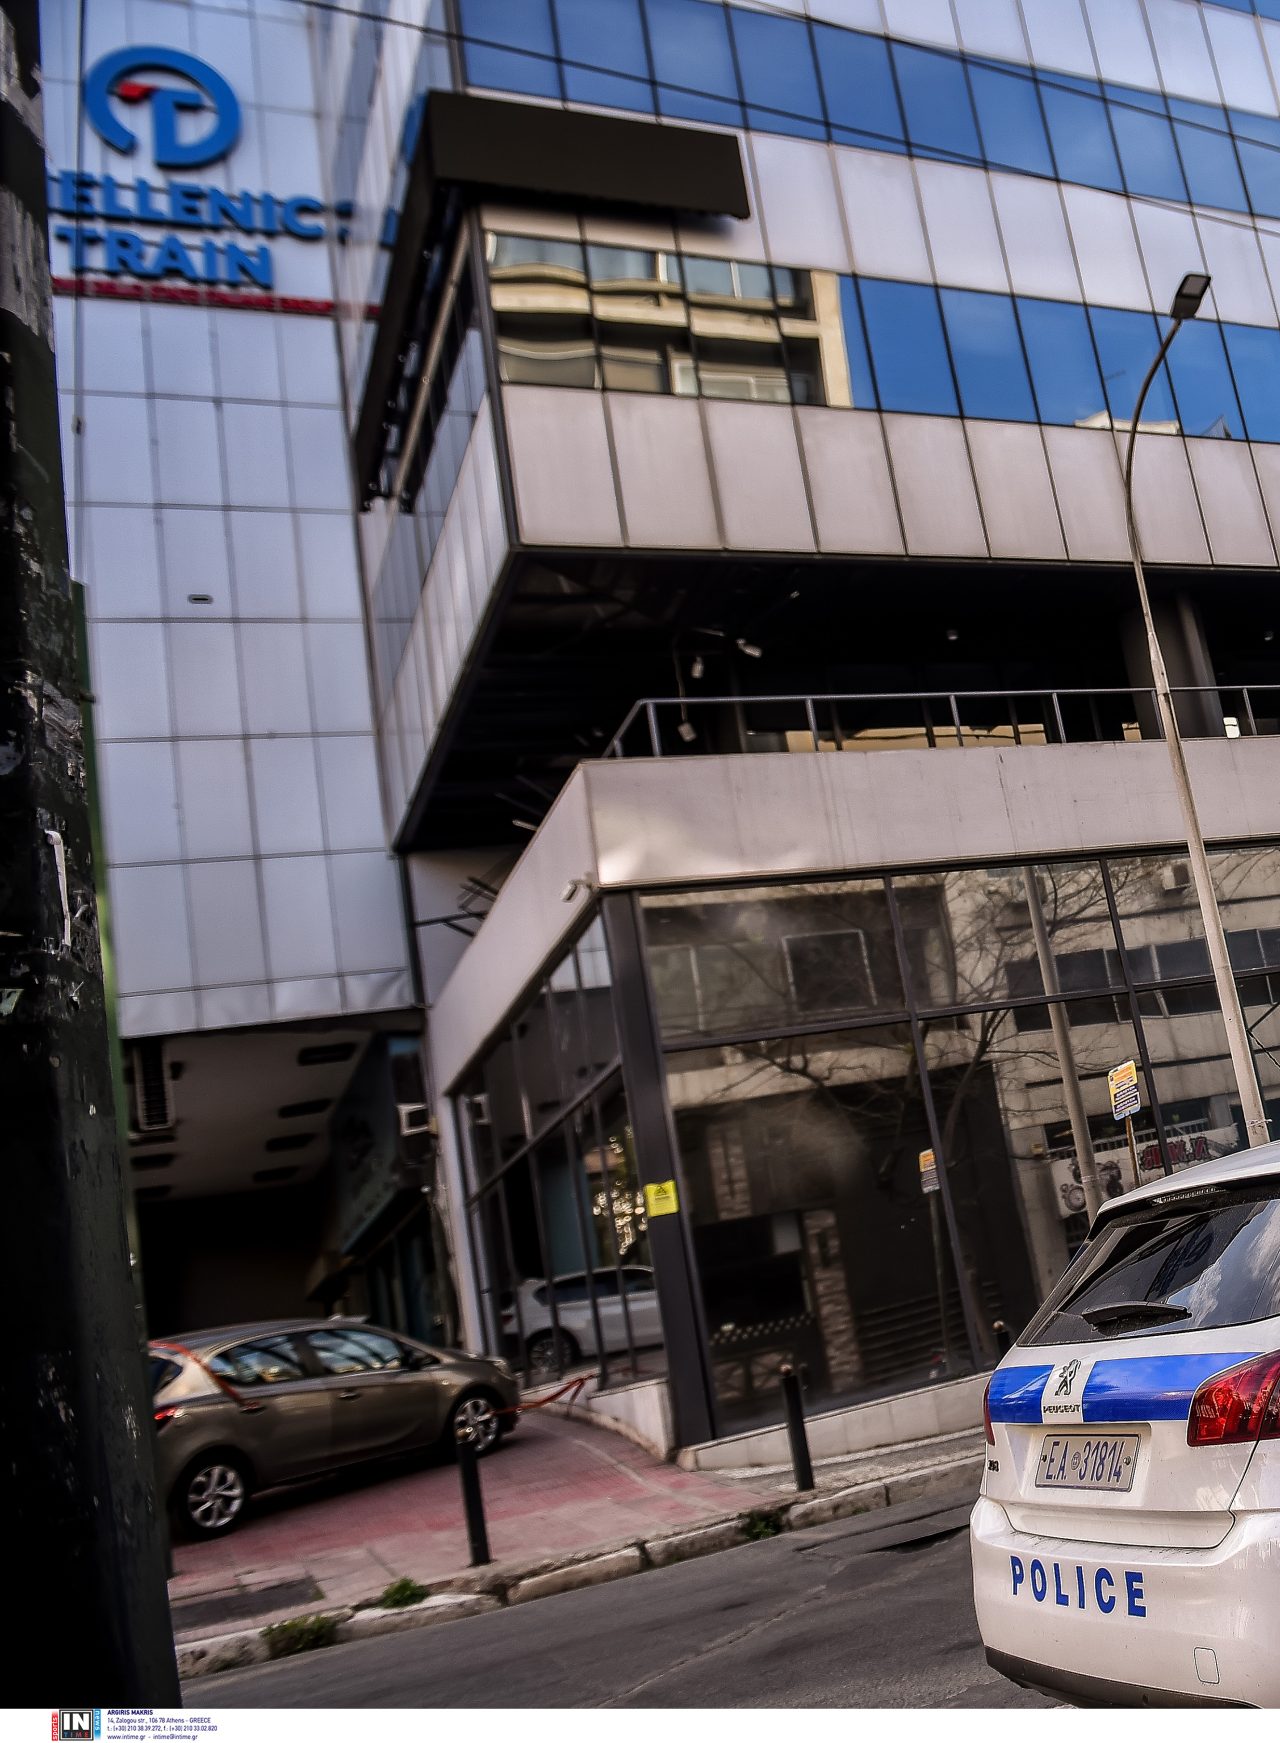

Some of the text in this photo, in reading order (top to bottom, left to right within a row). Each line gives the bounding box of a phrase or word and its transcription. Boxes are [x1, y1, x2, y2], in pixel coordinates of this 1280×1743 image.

[54, 224, 274, 291] TRAIN
[1043, 1404, 1080, 1413] PEUGEOT
[1079, 1440, 1125, 1482] 31814
[1010, 1555, 1147, 1618] POLICE
